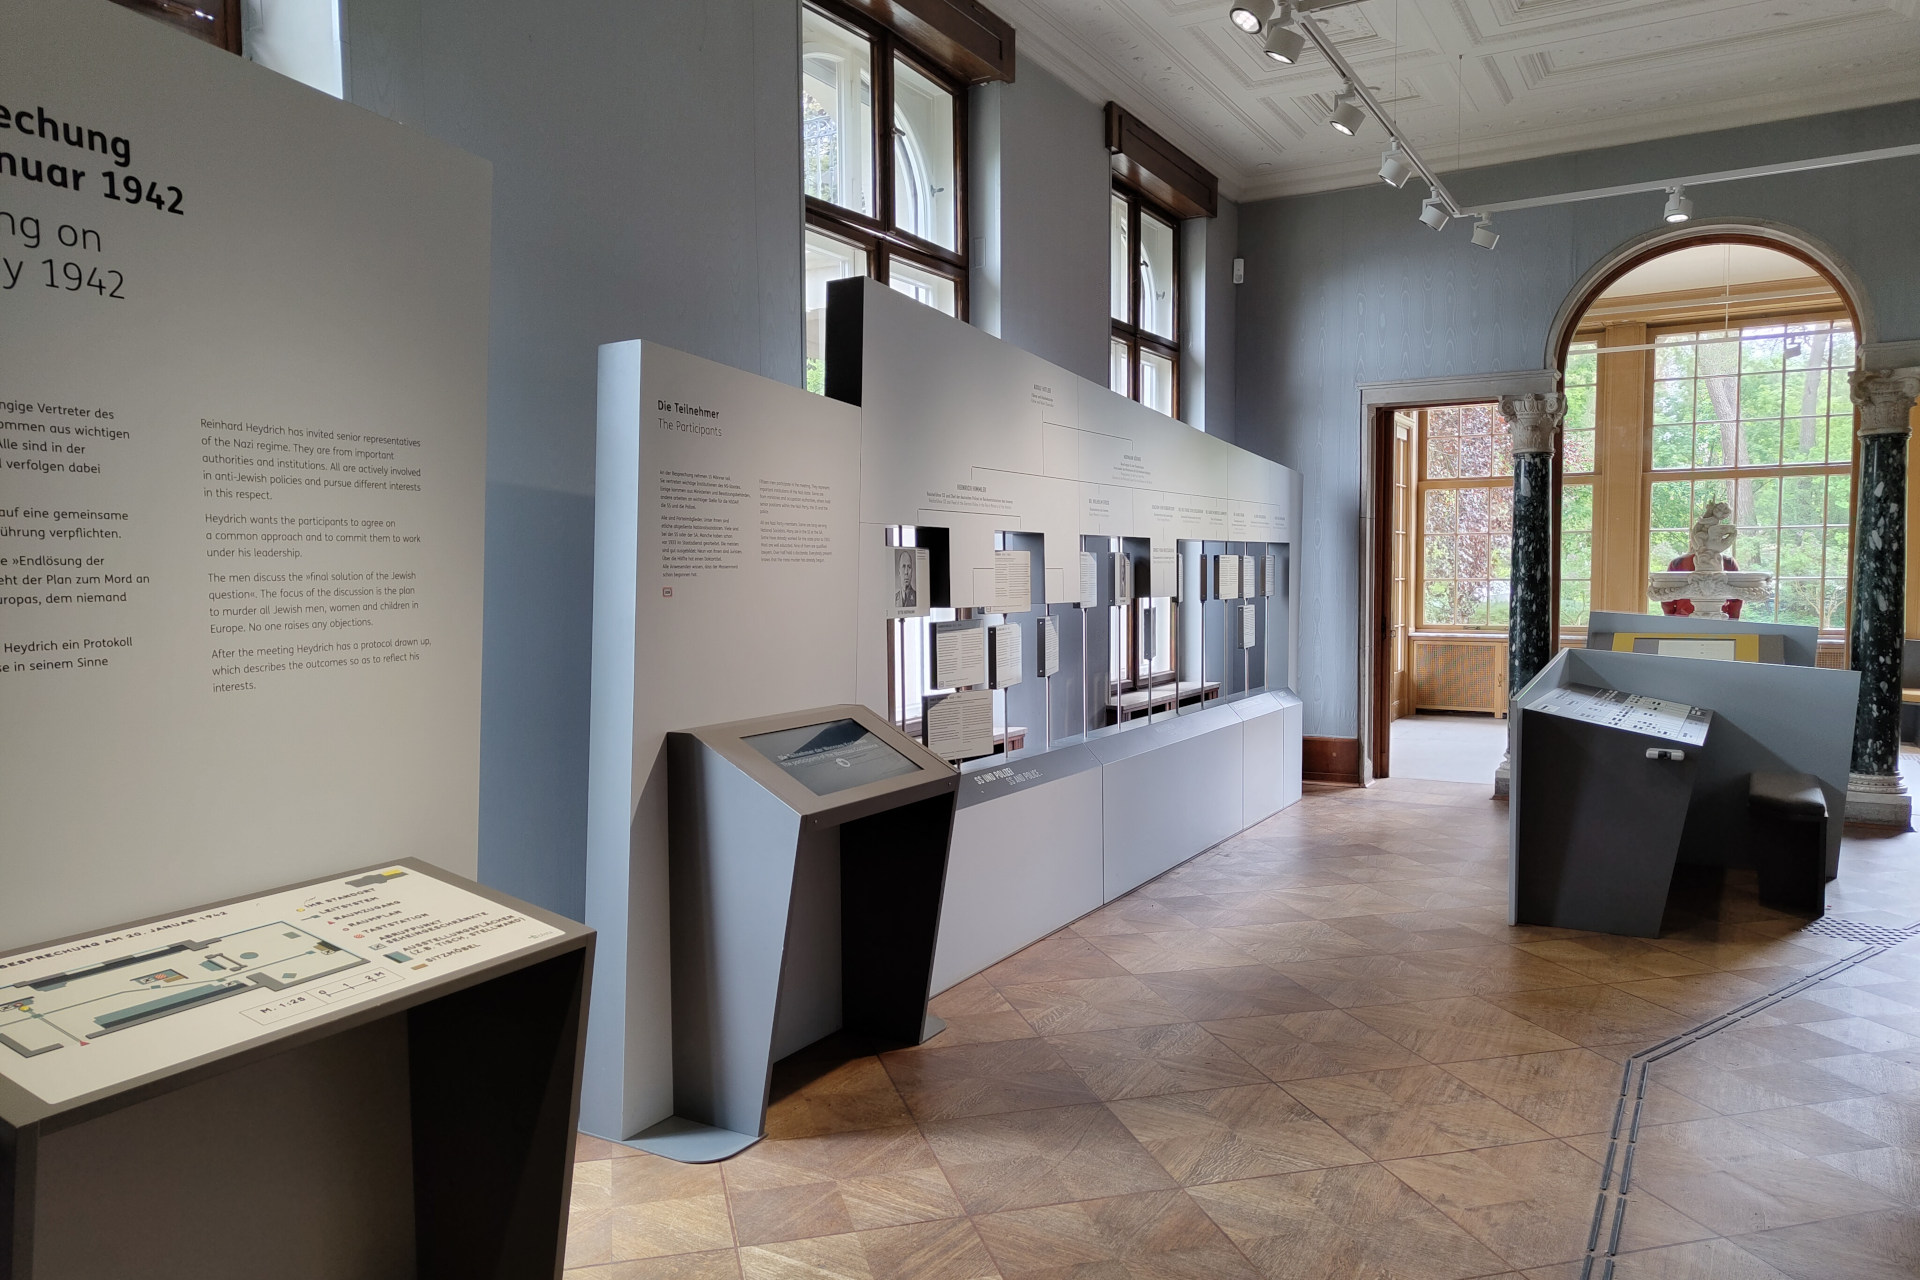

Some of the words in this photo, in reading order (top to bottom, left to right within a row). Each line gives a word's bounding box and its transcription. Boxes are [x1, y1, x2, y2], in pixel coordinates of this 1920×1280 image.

[0, 104, 130, 167] echung
[0, 152, 85, 191] nuar
[102, 171, 184, 215] 1942
[57, 224, 101, 252] on
[3, 258, 23, 289] y
[42, 259, 125, 299] 1942
[36, 402, 91, 418] Vertreter
[94, 407, 115, 420] des
[657, 400, 671, 412] Die
[674, 403, 719, 419] Teilnehmer
[49, 425, 71, 435] aus
[74, 425, 130, 441] wichtigen
[200, 418, 243, 432] Reinhard
[246, 423, 285, 436] Heydrich
[288, 427, 303, 437] has
[306, 428, 334, 440] invited
[337, 432, 361, 442] senior
[364, 436, 421, 447] representatives
[658, 418, 673, 431] The
[676, 421, 722, 437] Participants
[22, 439, 48, 452] sind
[51, 441, 62, 453] in
[66, 442, 86, 455] der
[202, 436, 211, 446] of
[214, 437, 231, 448] the
[233, 439, 253, 449] Nazi
[257, 441, 290, 453] regime.
[293, 443, 314, 456] They
[317, 447, 330, 455] are
[333, 446, 352, 456] from
[355, 448, 394, 460] important
[5, 459, 65, 474] verfolgen
[67, 461, 101, 474] dabei
[202, 454, 253, 466] authorities
[257, 458, 274, 467] and
[277, 458, 327, 471] institutions.
[330, 462, 340, 471] All
[359, 465, 388, 477] actively
[391, 467, 421, 476] involved
[204, 487, 212, 497] in
[216, 488, 233, 498] this
[236, 491, 272, 501] respect.
[0, 506, 20, 518] auf
[23, 507, 49, 519] eine
[53, 509, 129, 522] gemeinsame
[205, 513, 247, 526] Heydrich
[250, 516, 278, 525] wants
[281, 516, 295, 525] the
[298, 517, 348, 528] participants
[351, 519, 358, 527] to
[361, 521, 383, 529] agree
[0, 525, 46, 541] ührung
[49, 527, 122, 541] verpflichten.
[206, 532, 212, 540] a
[261, 532, 302, 543] approach
[306, 532, 322, 541] and
[325, 533, 333, 541] to
[336, 533, 367, 542] commit
[370, 534, 390, 542] them
[12, 555, 82, 569] »Endlösung
[84, 555, 105, 566] der
[207, 548, 235, 557] under
[238, 548, 251, 557] his
[254, 548, 302, 560] leadership.
[22, 574, 43, 585] der
[46, 573, 72, 585] Plan
[74, 576, 103, 585] zum
[104, 573, 133, 584] Mord
[135, 575, 150, 584] an
[208, 573, 226, 582] The
[254, 573, 286, 582] discuss
[289, 572, 303, 581] the
[331, 572, 363, 581] solution
[366, 572, 373, 580] of
[376, 572, 389, 580] the
[391, 572, 416, 580] Jewish
[45, 592, 75, 604] dem
[76, 591, 127, 603] niemand
[211, 624, 246, 635] Europe.
[249, 622, 261, 632] No
[284, 621, 309, 630] raises
[312, 622, 327, 631] any
[330, 619, 373, 630] objections.
[4, 640, 58, 656] Heydrich
[62, 639, 80, 650] ein
[83, 636, 133, 649] Protokoll
[212, 649, 235, 659] After
[238, 647, 254, 657] the
[257, 646, 294, 657] meeting
[297, 643, 333, 655] Heydrich
[336, 642, 350, 651] has
[361, 640, 392, 652] protocol
[394, 639, 418, 648] drawn
[421, 640, 431, 648] up,
[13, 661, 25, 672] in
[29, 658, 75, 671] seinem
[77, 656, 109, 668] Sinne
[213, 681, 256, 693] interests.
[974, 776, 984, 785] SS
[983, 773, 996, 783] UND
[993, 768, 1014, 780] POLIZEI
[325, 888, 376, 902] STANDORT
[319, 896, 379, 914] LEITSYSTEM
[333, 900, 400, 920] RAUMZUGANG
[347, 910, 402, 927] RAUMPLAN
[362, 912, 430, 934] TASTSTATION
[379, 919, 442, 941] ABRUFPUNKT
[402, 914, 515, 952] AUSSTELLUNGSFLÄCHEN
[436, 935, 469, 946] TISCH,
[470, 917, 526, 937] STELLWAND)
[0, 942, 100, 969] BESPRECHUNG
[105, 936, 123, 944] AM
[150, 918, 197, 933] JANUAR
[200, 911, 228, 920] 1942
[425, 943, 482, 962] SITZMÖBEL
